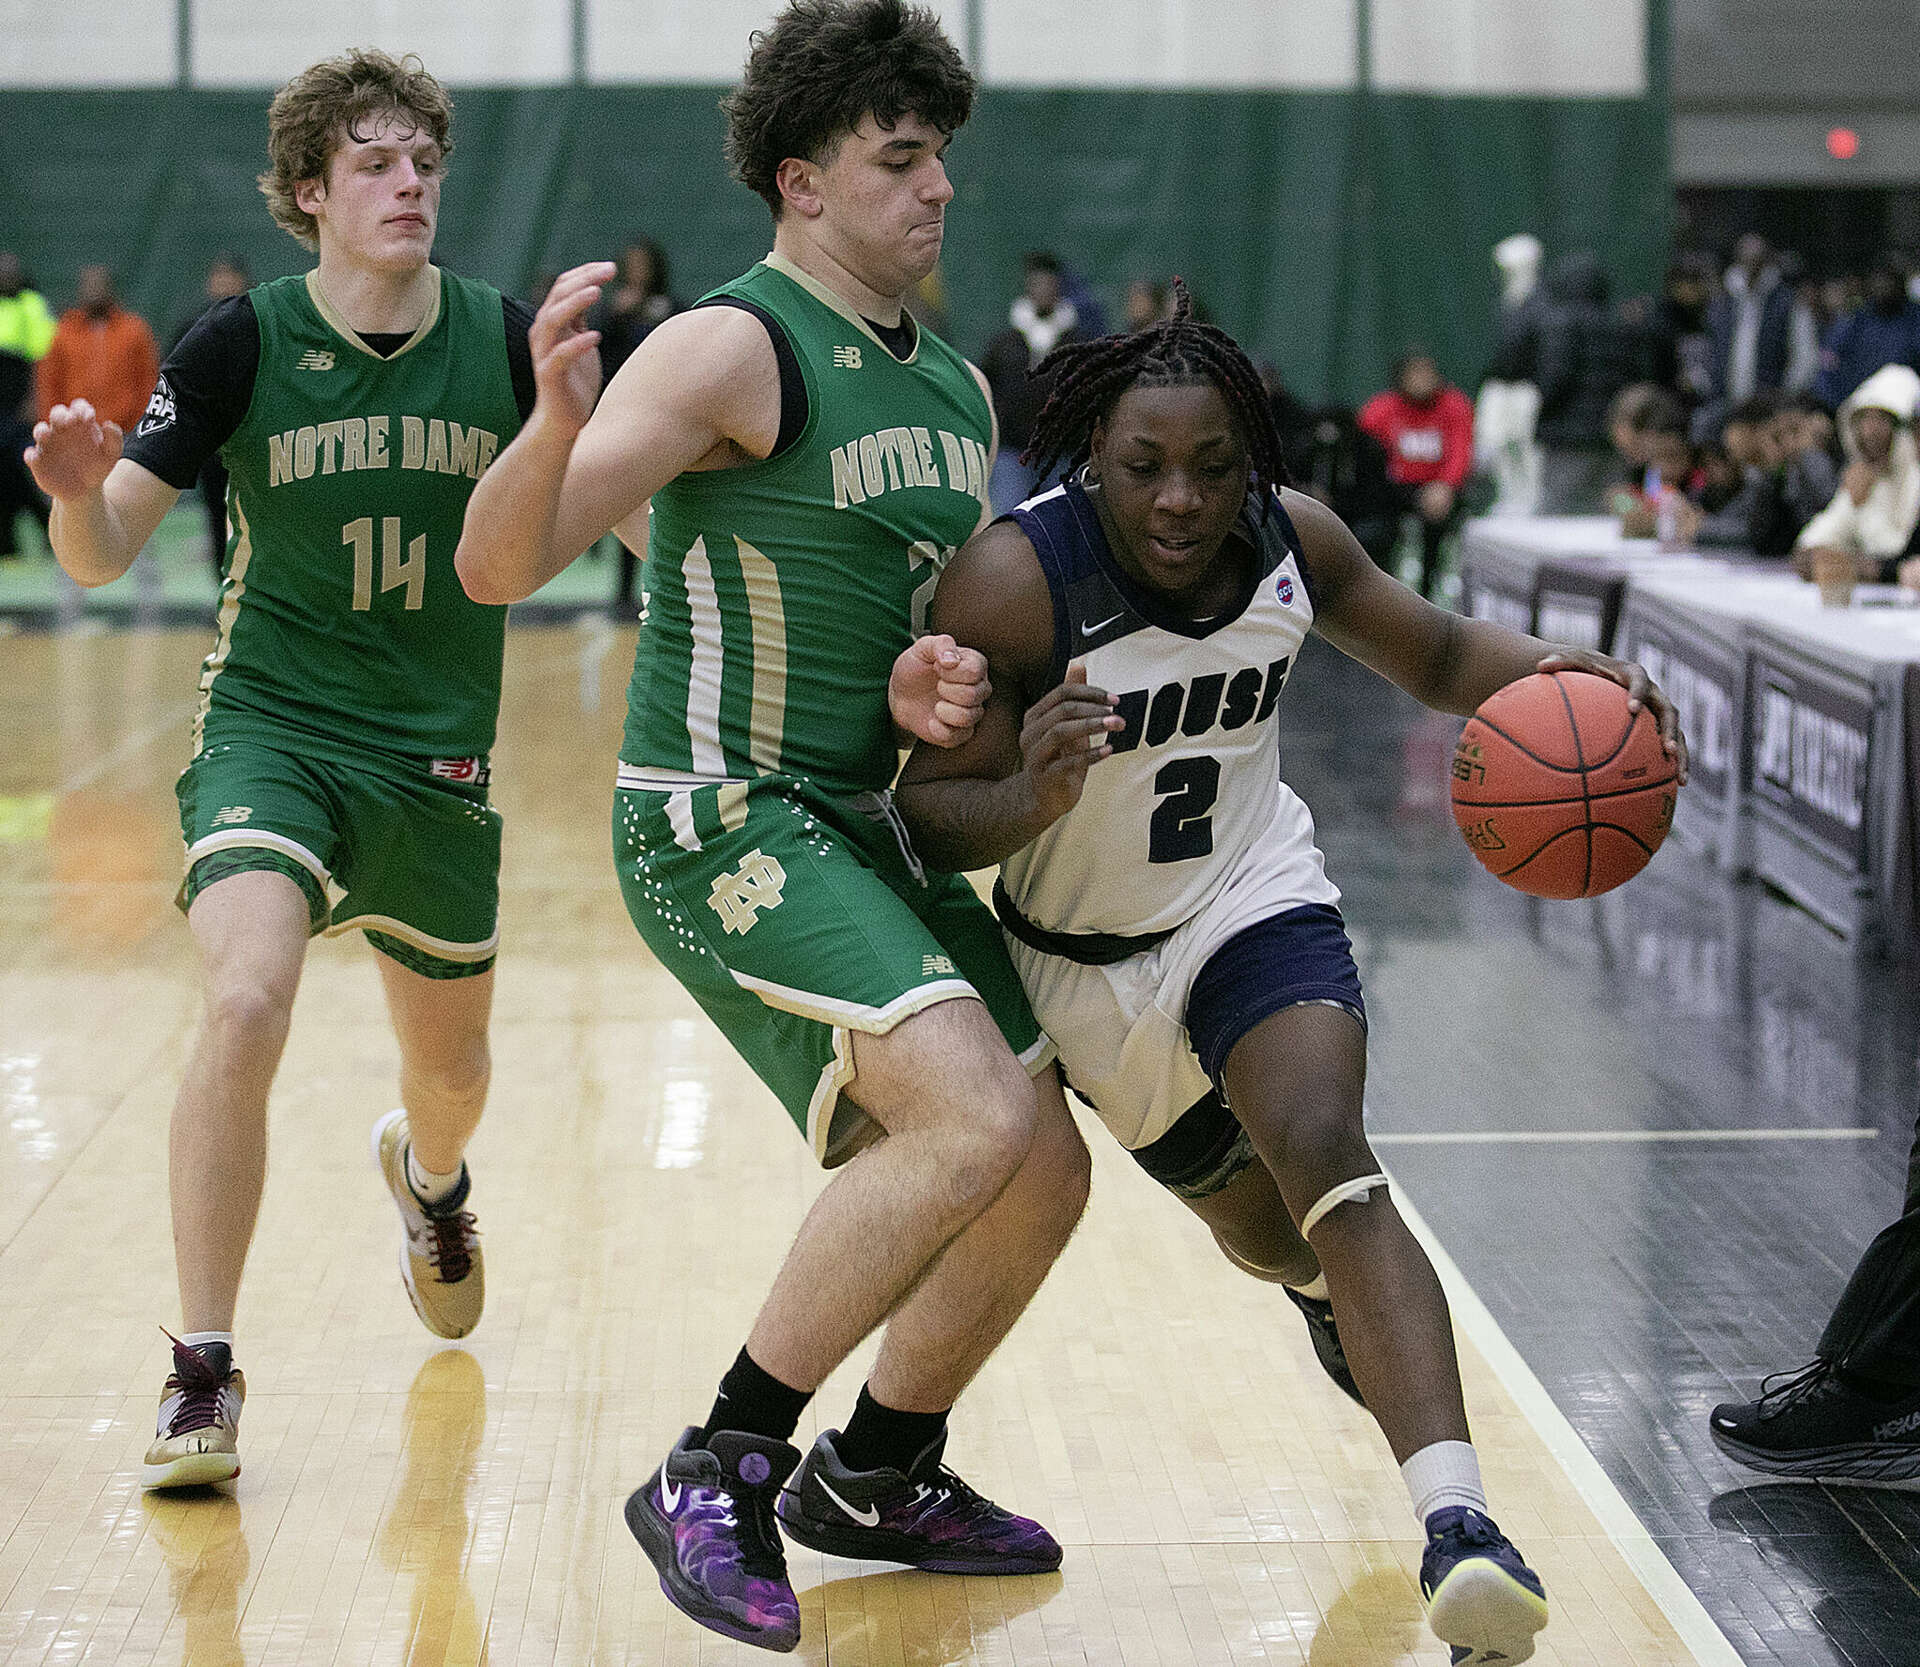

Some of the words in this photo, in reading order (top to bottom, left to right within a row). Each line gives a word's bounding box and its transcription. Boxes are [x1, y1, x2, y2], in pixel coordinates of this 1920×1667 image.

[268, 415, 390, 488] NOTRE
[401, 415, 499, 481] DAME
[830, 426, 941, 510] NOTRE
[937, 429, 988, 504] DA
[342, 516, 427, 611] 14
[1148, 755, 1222, 864] 2
